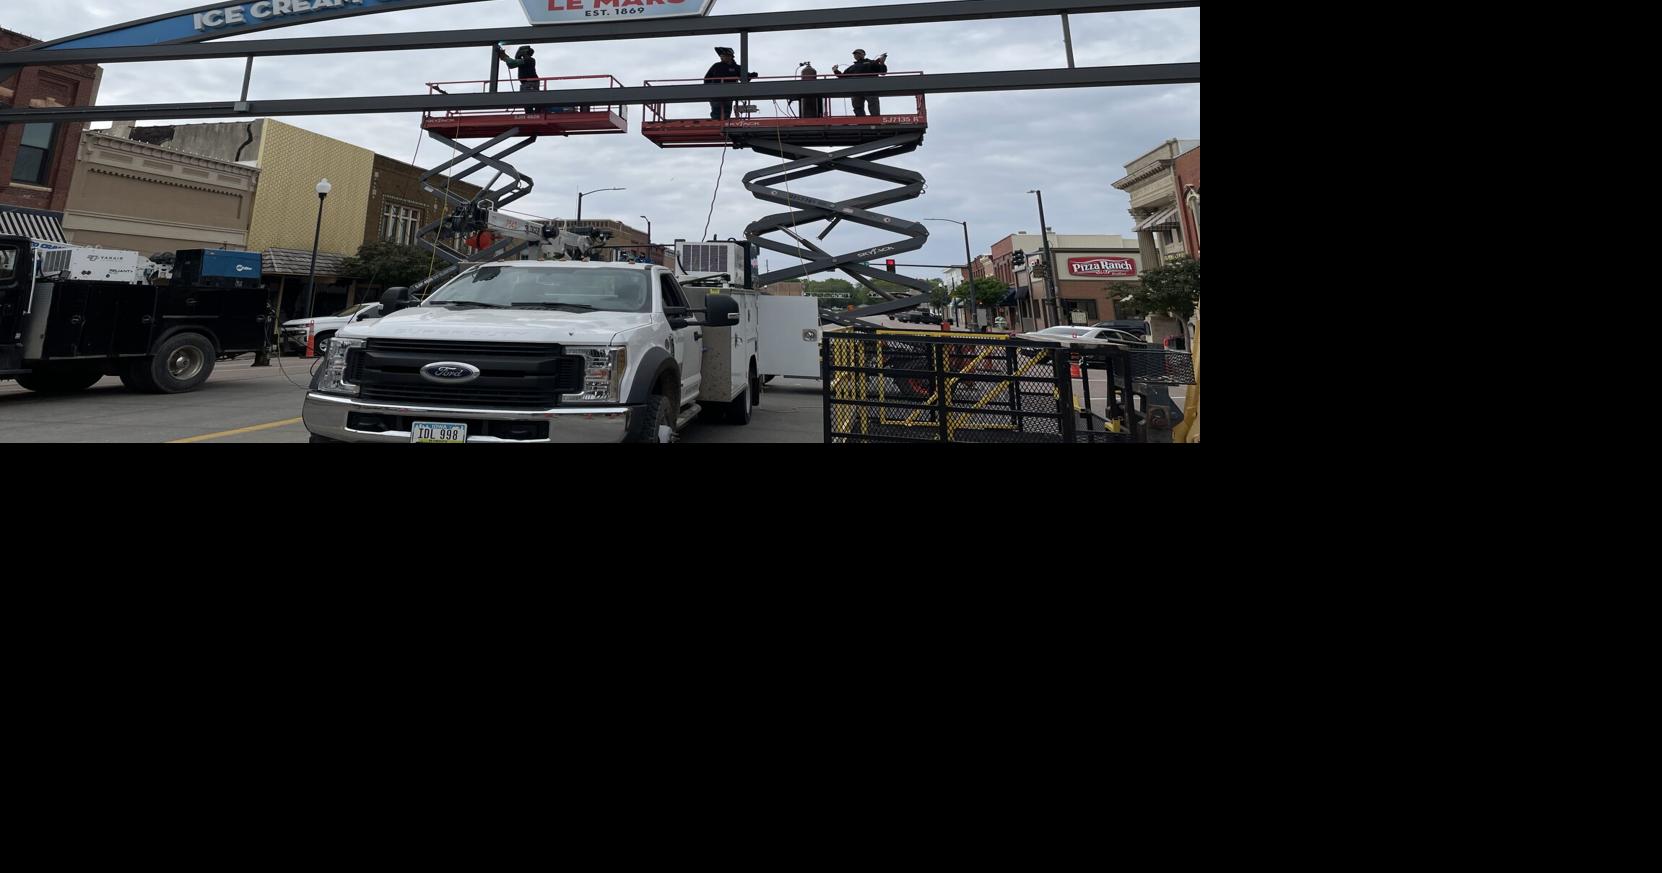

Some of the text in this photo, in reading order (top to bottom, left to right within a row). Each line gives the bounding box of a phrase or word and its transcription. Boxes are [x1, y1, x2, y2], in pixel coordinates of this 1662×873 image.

[594, 0, 685, 9] MA
[193, 0, 362, 30] ICE CREA
[615, 7, 645, 15] 1869
[857, 246, 895, 258] SKYJACK
[1072, 262, 1100, 273] Pizza
[1100, 260, 1133, 271] Ranch
[434, 366, 463, 377] Ford
[440, 429, 459, 440] 998
